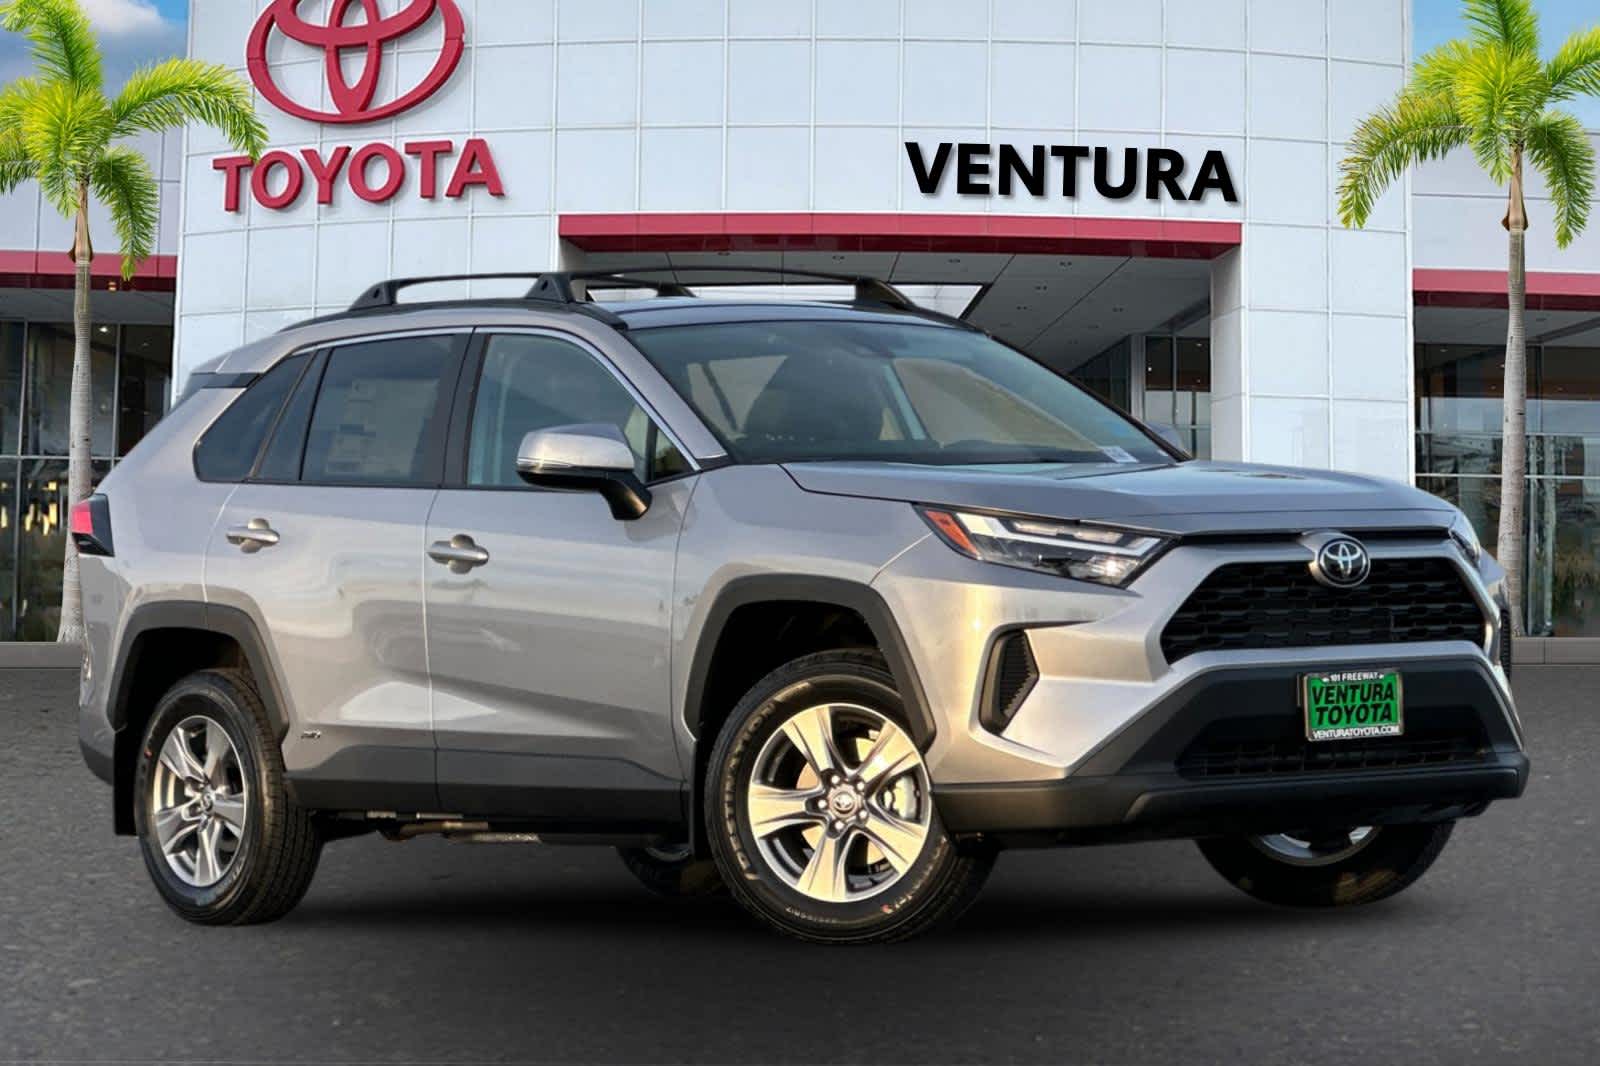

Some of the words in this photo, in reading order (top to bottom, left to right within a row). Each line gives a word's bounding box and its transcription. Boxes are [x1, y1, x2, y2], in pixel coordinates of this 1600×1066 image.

[213, 138, 505, 212] TOYOTA
[904, 142, 1238, 202] VENTURA
[1342, 672, 1378, 681] FREEWAY
[1312, 683, 1394, 705] VENTURA
[1315, 703, 1392, 725] TOYOTA
[1313, 725, 1399, 739] VENTURATOYOTA.COM
